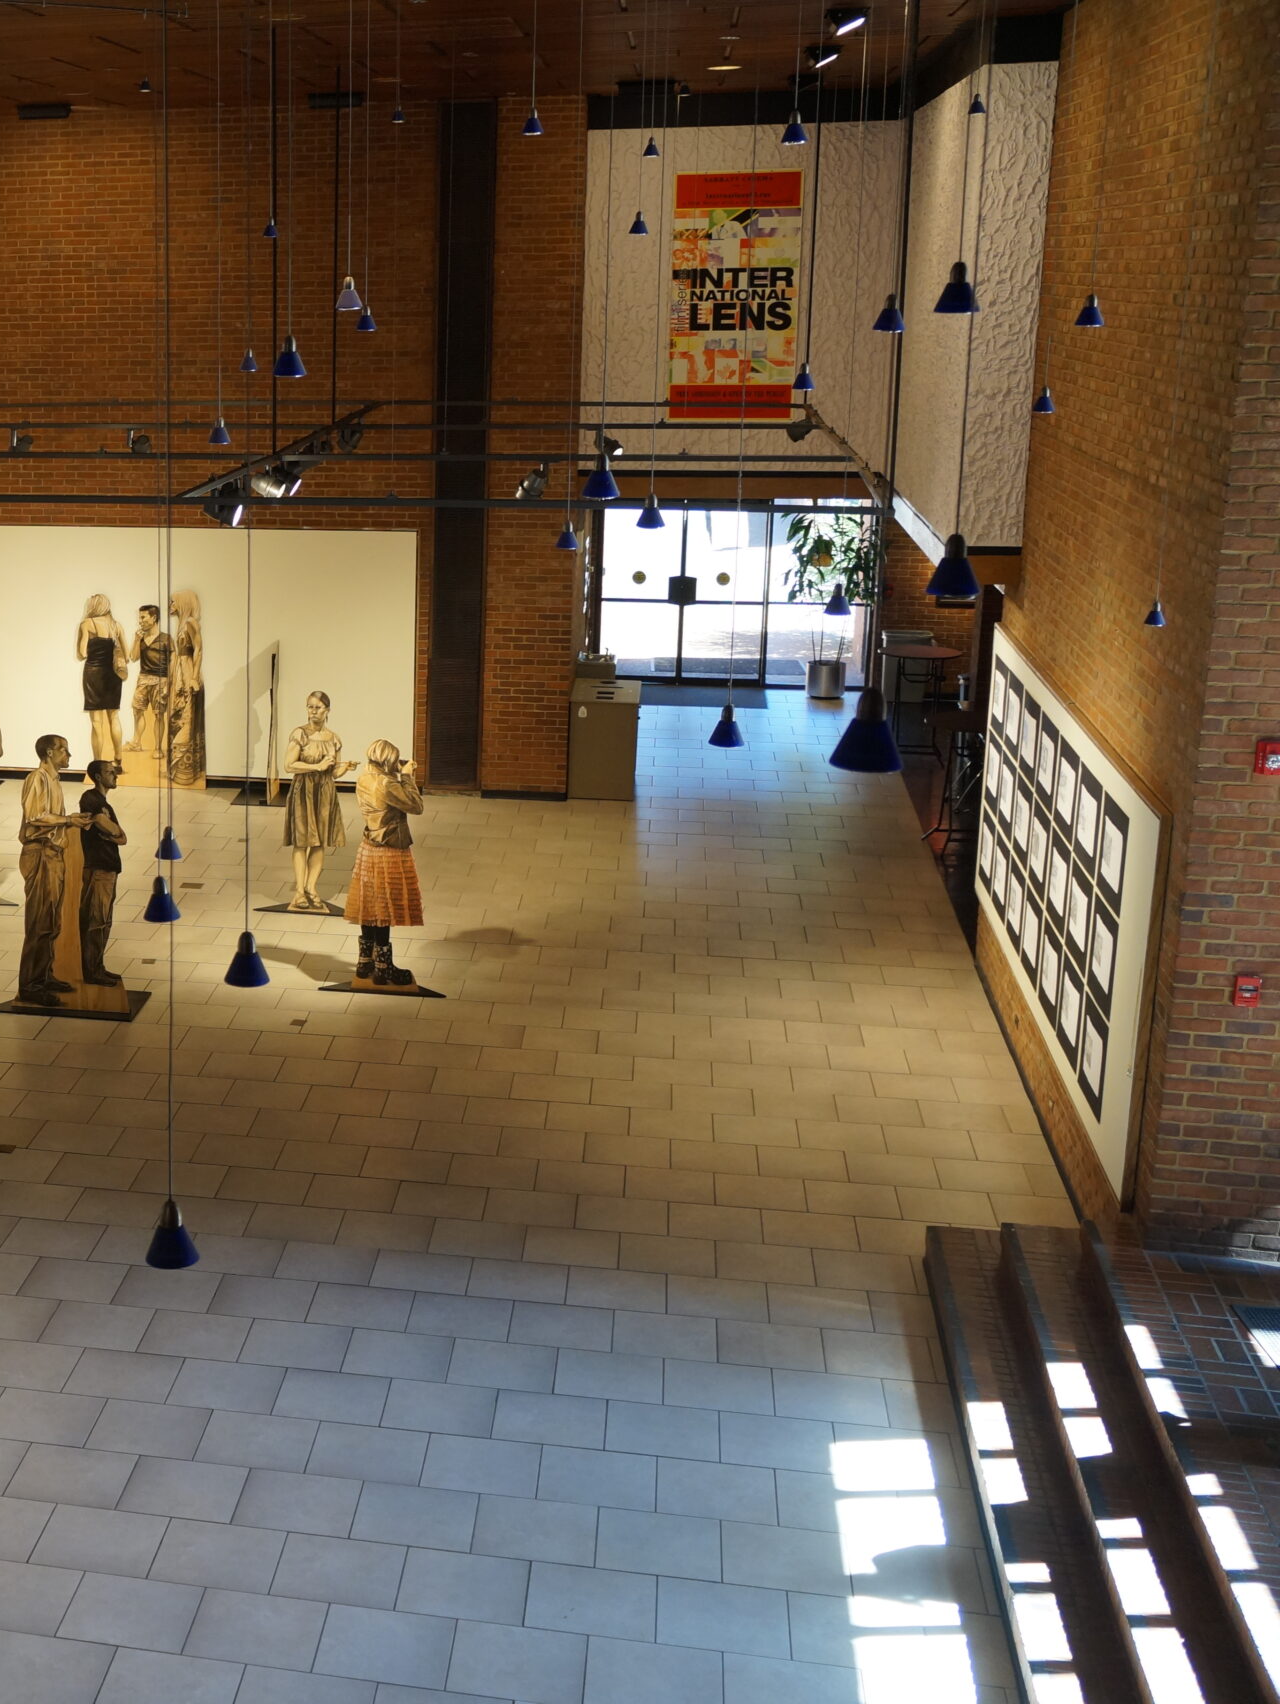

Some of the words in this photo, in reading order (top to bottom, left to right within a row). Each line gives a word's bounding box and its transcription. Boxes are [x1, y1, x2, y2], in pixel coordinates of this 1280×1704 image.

[691, 267, 794, 289] INTER
[690, 288, 793, 302] NATIONAL
[689, 301, 792, 331] LENS
